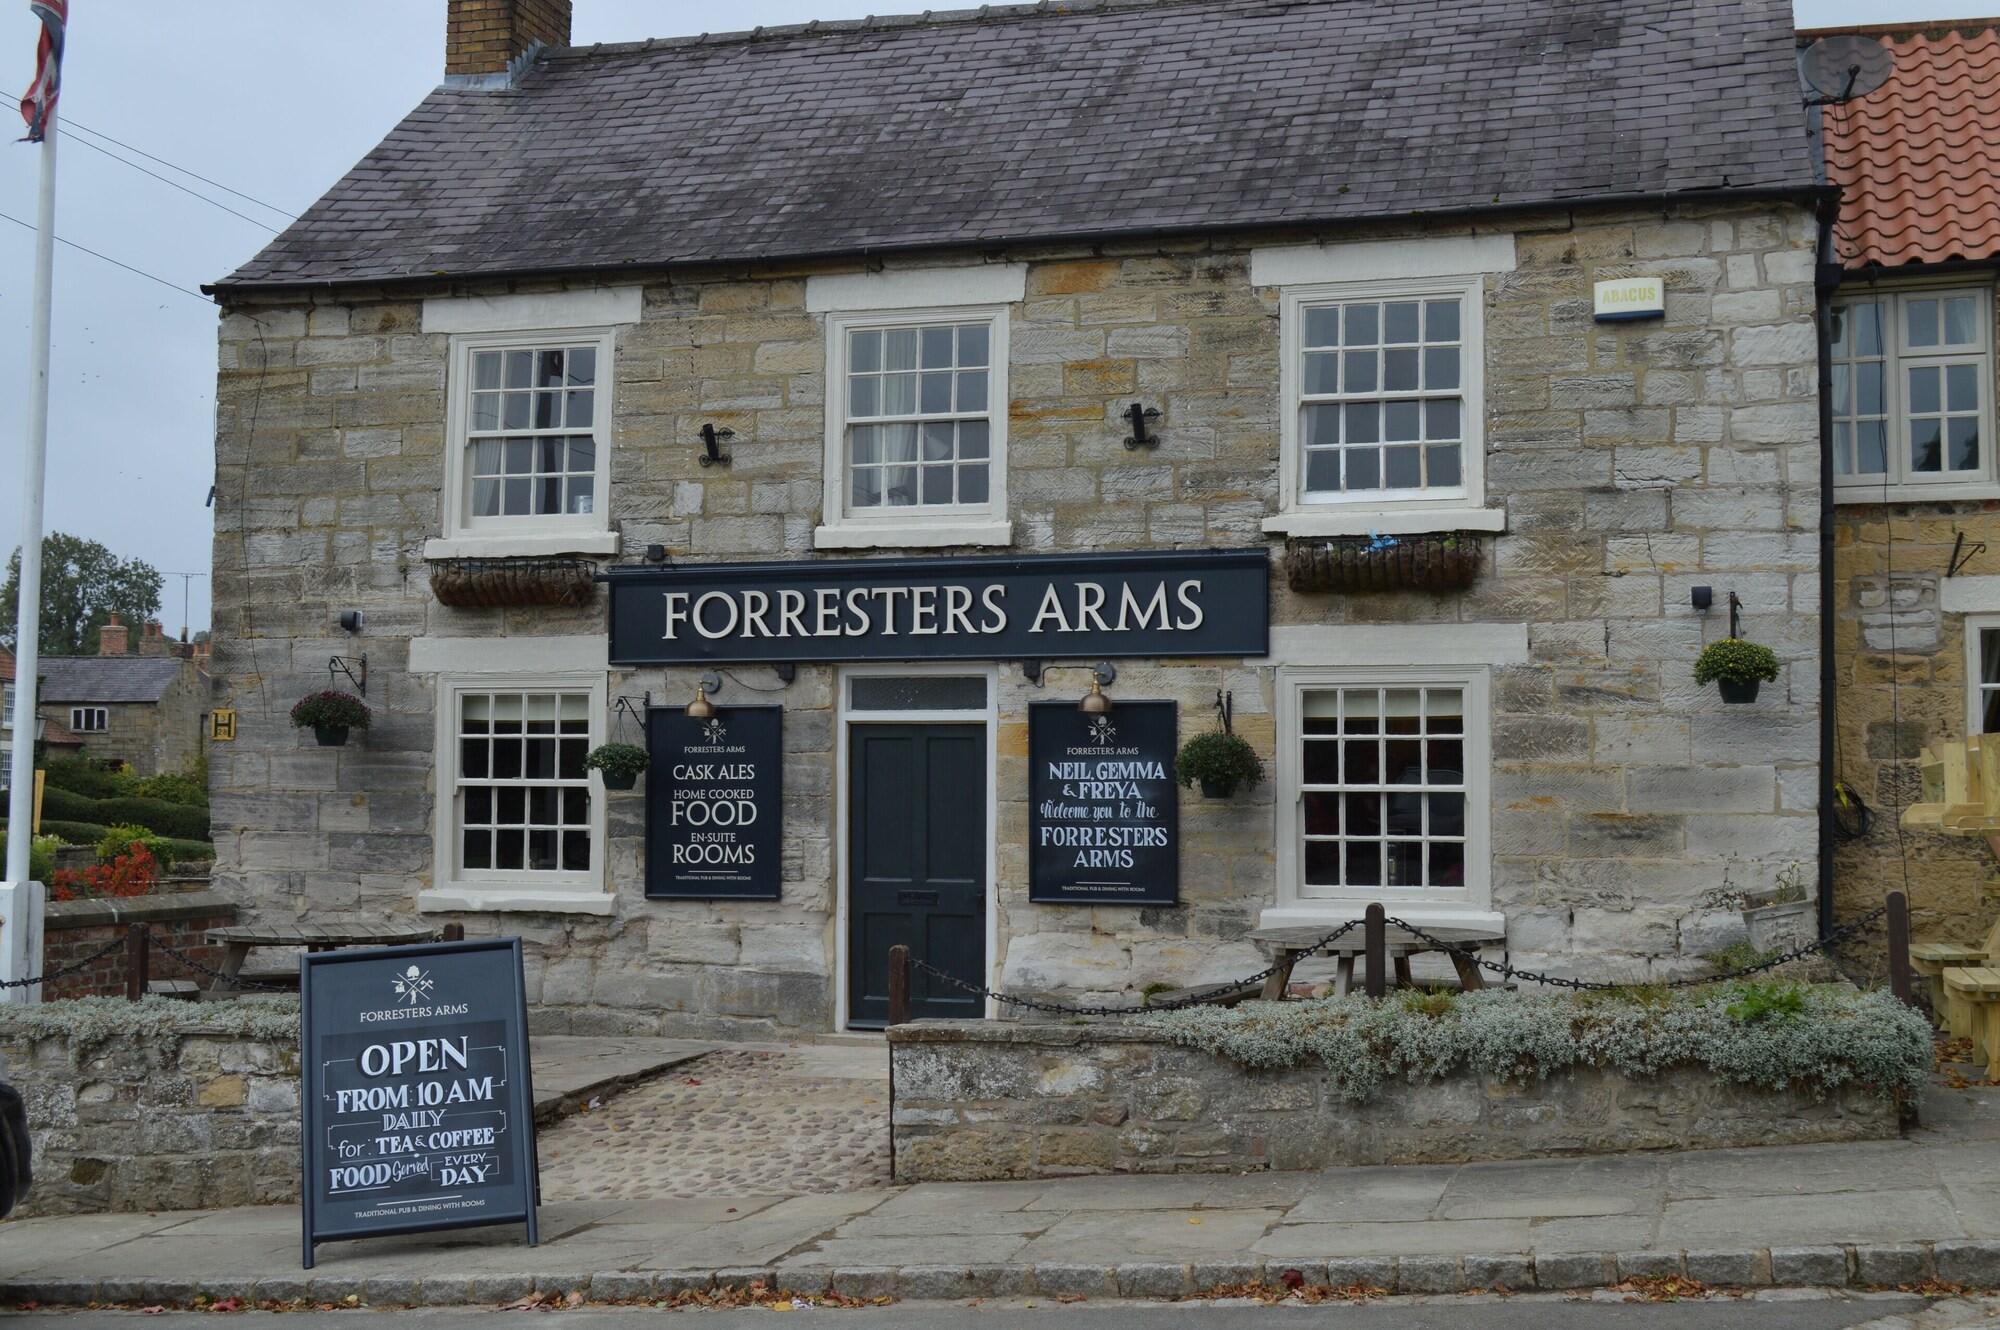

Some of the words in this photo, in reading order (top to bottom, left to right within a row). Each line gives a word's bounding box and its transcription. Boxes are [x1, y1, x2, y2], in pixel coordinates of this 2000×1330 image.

[1602, 287, 1656, 304] ABACUS
[662, 584, 1008, 640] FORRESTERS
[1028, 579, 1205, 633] ARMS
[214, 713, 231, 737] H
[726, 745, 746, 753] ARMS
[1066, 747, 1114, 755] FORRESTERS
[1116, 747, 1139, 755] ARMS
[673, 765, 714, 780] CASK
[718, 764, 755, 779] ALES
[1096, 761, 1167, 780] GEMMA
[674, 790, 706, 800] HOME
[708, 789, 754, 799] COOKED
[1062, 783, 1078, 797] &
[1078, 781, 1143, 799] FREYA
[670, 800, 757, 826] FOOD
[1040, 799, 1091, 819] Welcome
[1092, 806, 1113, 822] you
[1119, 801, 1131, 818] to
[1135, 800, 1159, 818] the
[691, 832, 736, 842] EN-SUITE
[1040, 827, 1168, 847] FORRESTERS
[672, 844, 755, 864] ROOMS
[1073, 849, 1134, 868] ARMS
[360, 1006, 432, 1023] FORRESTERS
[434, 1003, 469, 1016] ARMS
[361, 1035, 468, 1076] OPEN
[335, 1084, 409, 1113] FROM
[382, 1109, 447, 1132] DAILY
[337, 1139, 365, 1158] for
[375, 1135, 415, 1155] TEA
[415, 1135, 427, 1148] &
[428, 1127, 495, 1150] COFFEE
[445, 1152, 486, 1166] EVERY
[329, 1163, 392, 1190] FOOD
[392, 1157, 430, 1182] Served
[440, 1164, 492, 1186] DAY
[354, 1208, 397, 1218] TRADITIONAL
[461, 1199, 486, 1208] ROOMS
